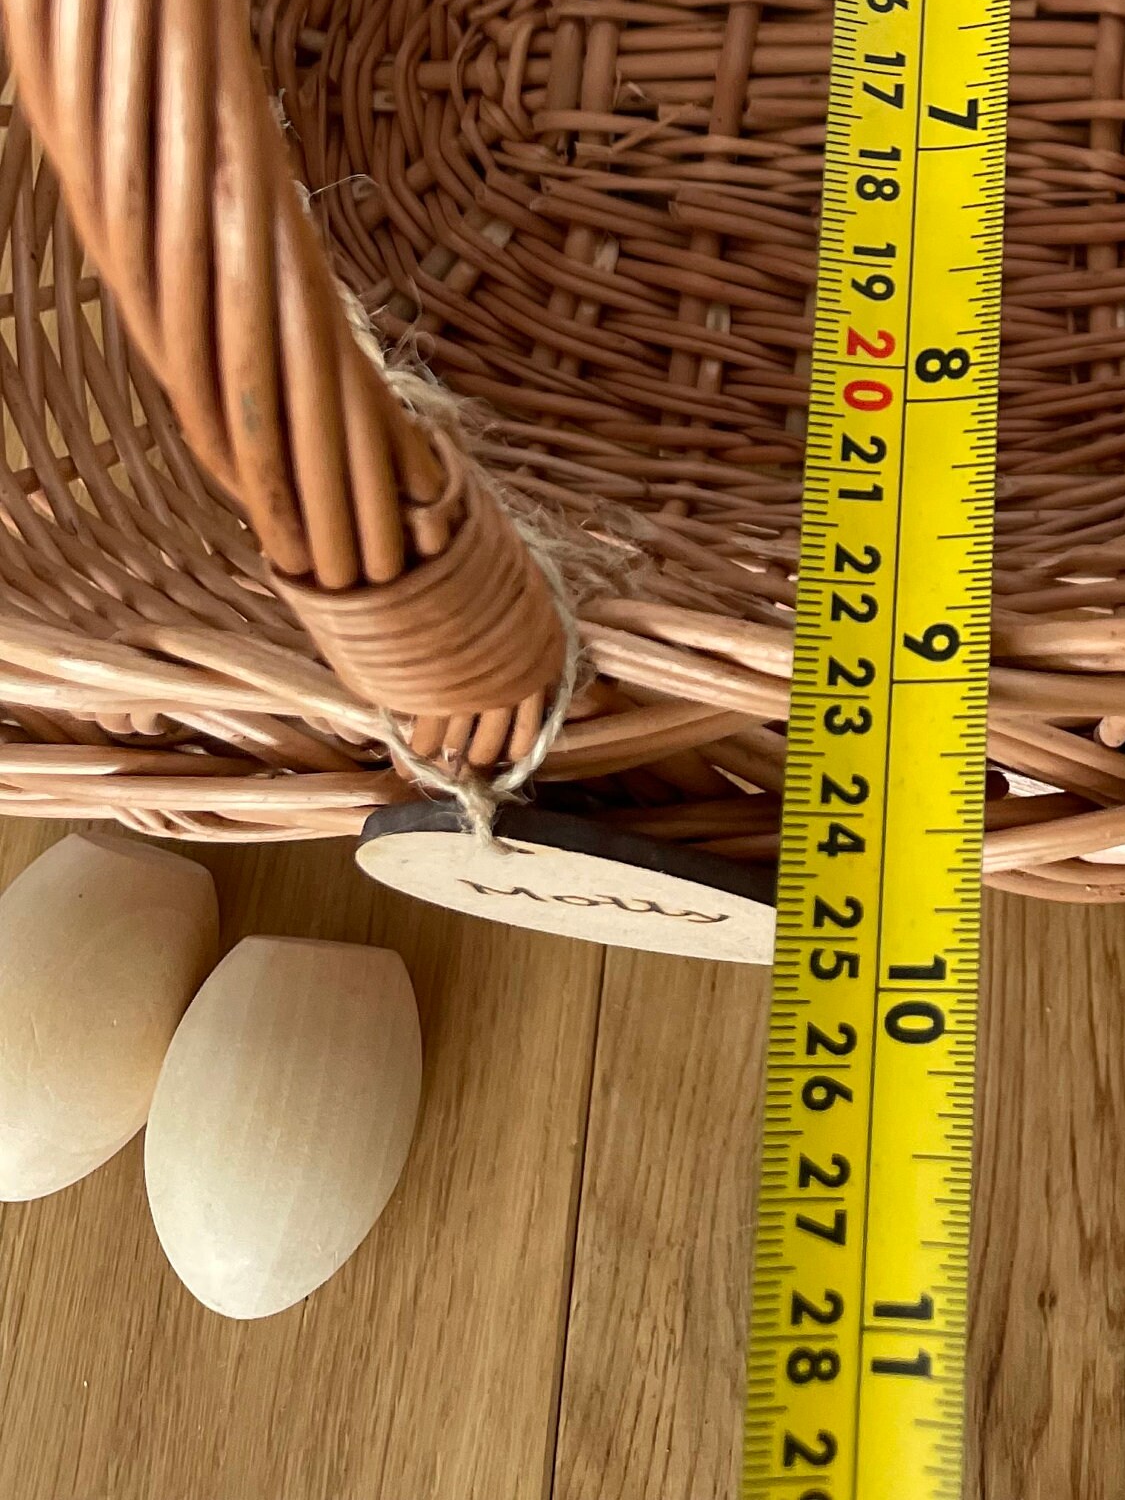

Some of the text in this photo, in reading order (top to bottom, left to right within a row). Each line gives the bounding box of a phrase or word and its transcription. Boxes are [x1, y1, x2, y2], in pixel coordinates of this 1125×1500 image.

[862, 51, 906, 109] 17
[927, 98, 979, 131] 7
[856, 145, 901, 201] 18
[851, 242, 897, 301] 19
[843, 326, 896, 412] 20
[915, 348, 970, 383] 8
[837, 432, 887, 501] 21
[830, 542, 882, 624] 22
[903, 623, 960, 662] 9
[823, 655, 876, 736] 23
[817, 771, 870, 857] 24
[457, 878, 730, 924] Molly
[810, 895, 865, 981] 25
[884, 954, 947, 1044] 10
[801, 1021, 857, 1112] 26
[795, 1152, 851, 1246] 27
[786, 1288, 845, 1385] 28
[870, 1292, 934, 1378] 11
[783, 1428, 838, 1500] 2
